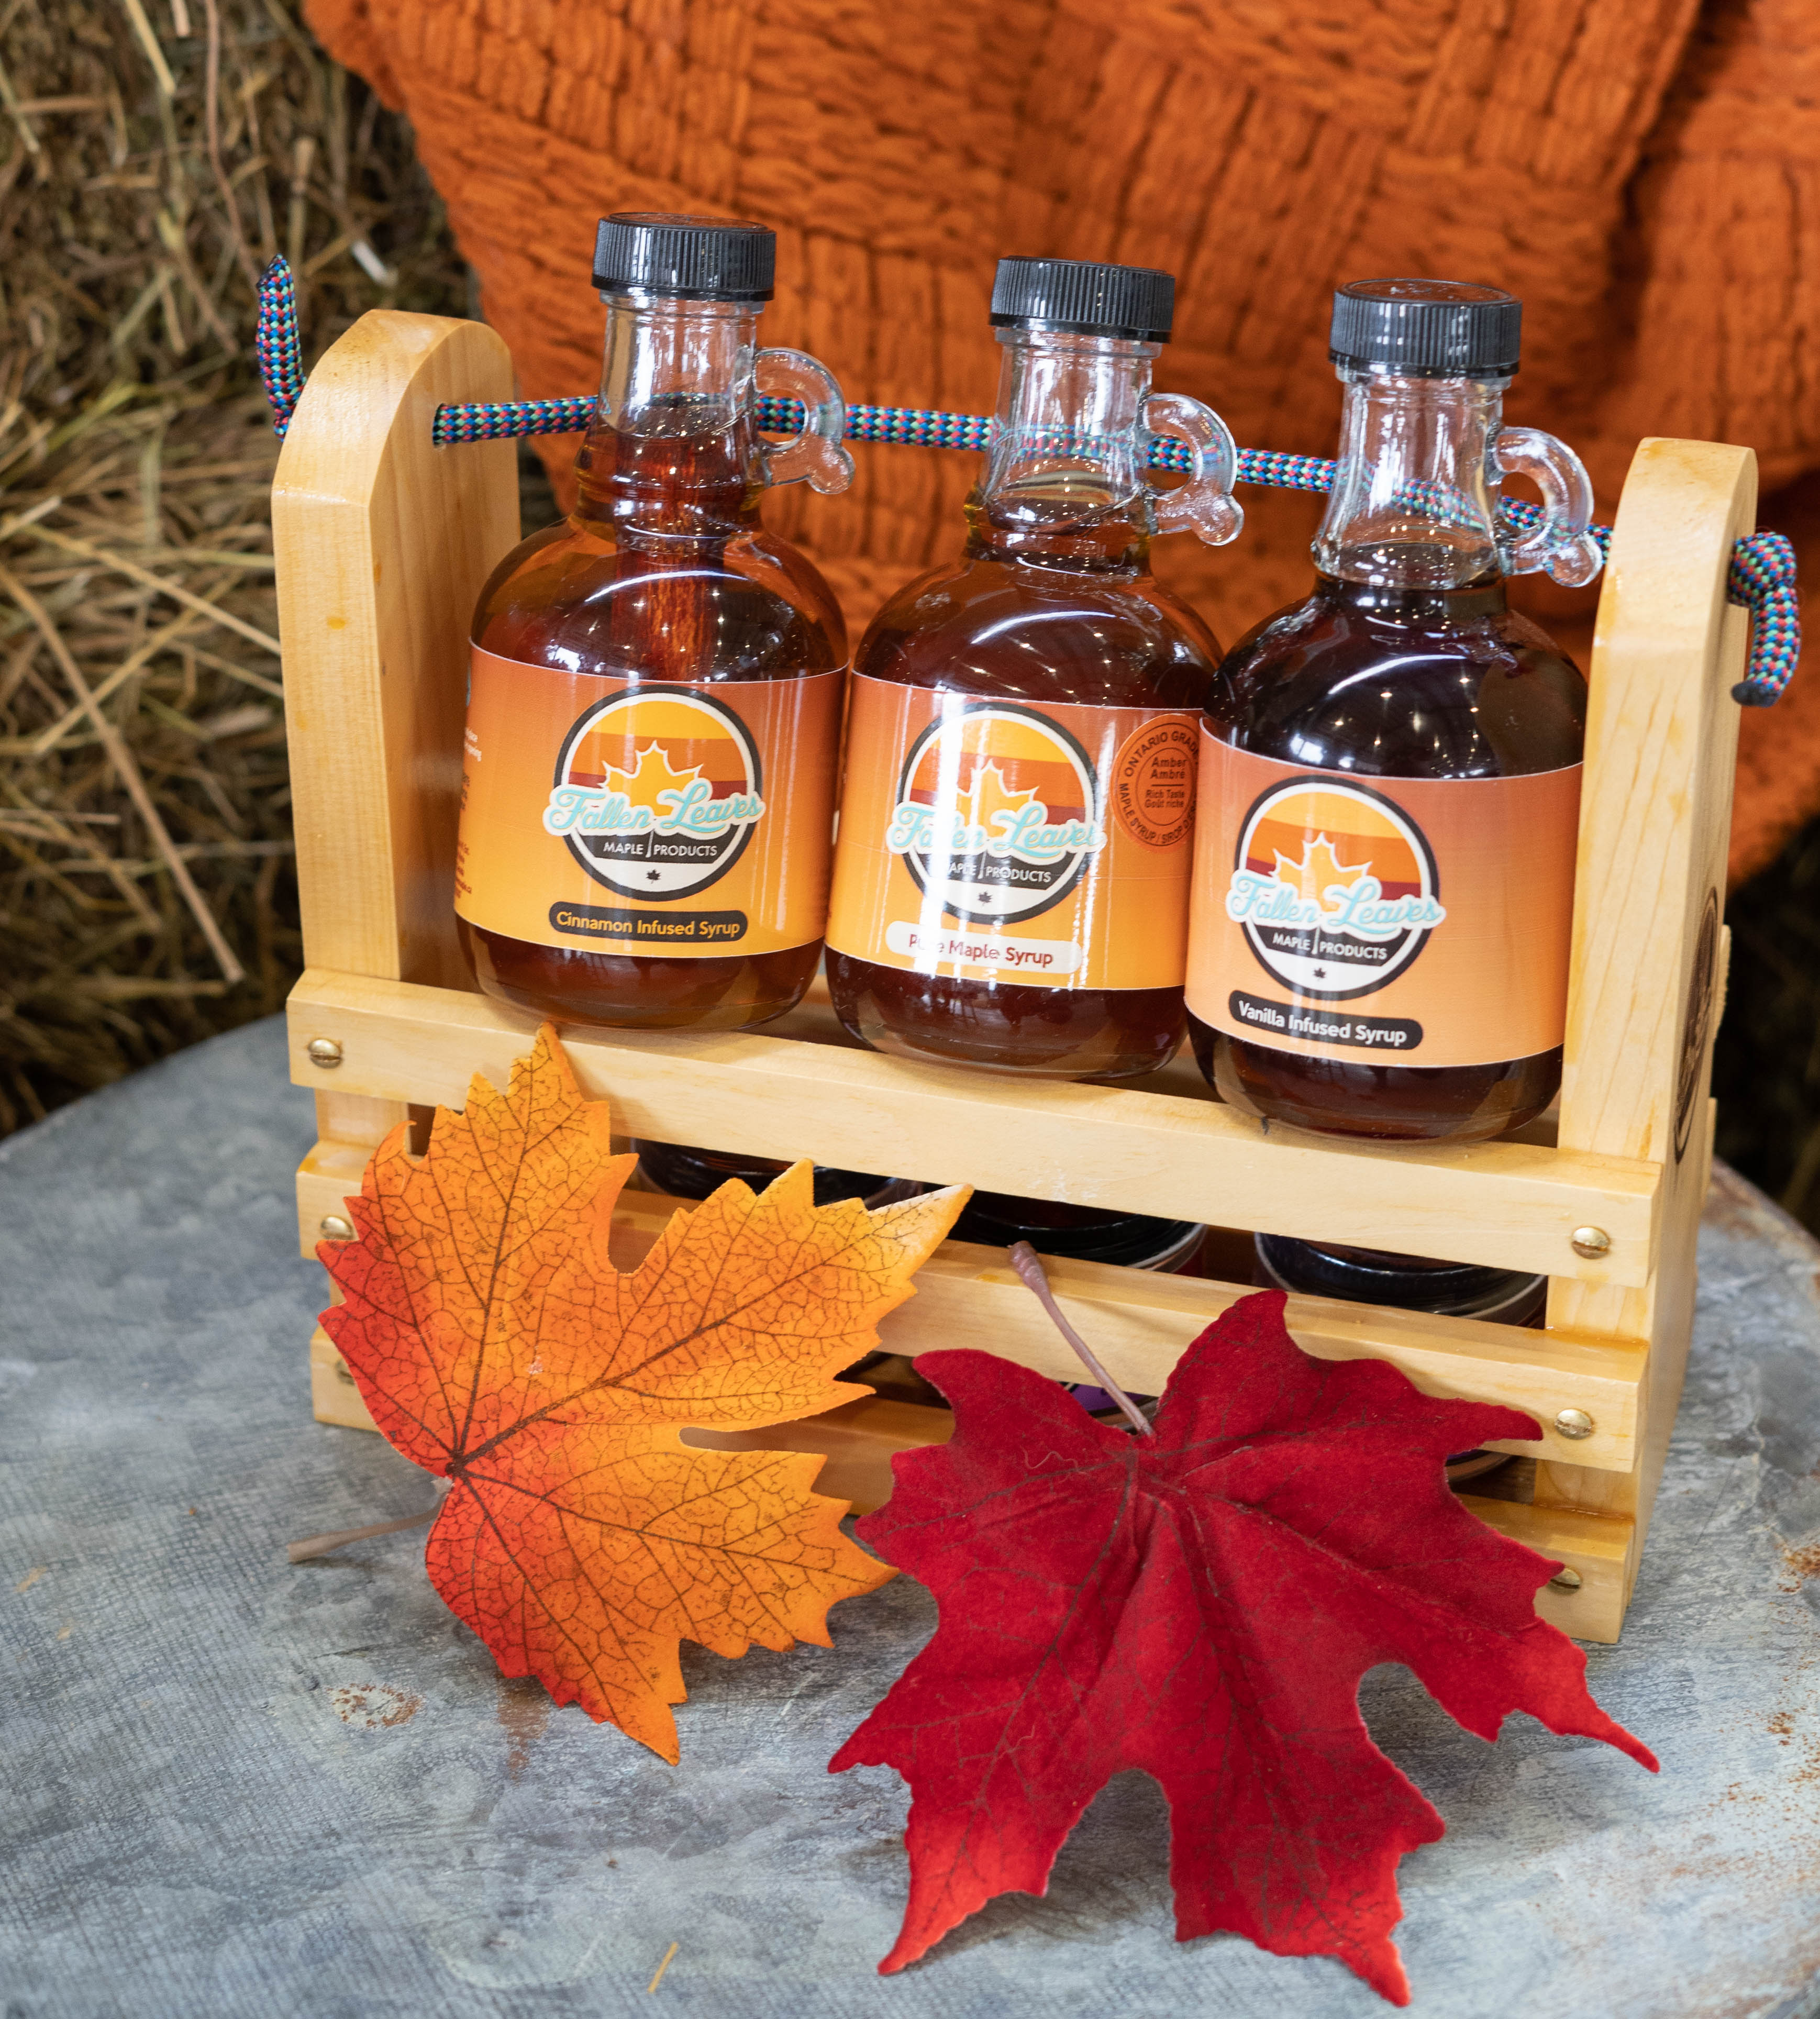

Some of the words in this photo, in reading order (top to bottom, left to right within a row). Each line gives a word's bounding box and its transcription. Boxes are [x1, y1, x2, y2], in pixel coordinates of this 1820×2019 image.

[1124, 732, 1168, 777] ONTARIO
[1151, 757, 1187, 767] Amber
[549, 789, 651, 830] Fallen
[660, 782, 762, 833] Leaves
[1119, 783, 1135, 819] MAPLE
[1130, 817, 1157, 840] SYRUP
[603, 841, 643, 856] MAPLE
[653, 846, 718, 856] PRODUCTS
[940, 860, 977, 877] APLE
[985, 866, 1051, 883] PRODUCTS
[1230, 876, 1317, 922] Fallen
[1327, 882, 1442, 934] Leaves
[556, 911, 632, 934] Cinnamon
[637, 920, 695, 936] Infused
[698, 921, 740, 939] Syrup
[949, 940, 1001, 961] Maple
[1005, 947, 1053, 968] Syrup
[1272, 933, 1311, 951] MAPLE
[1319, 941, 1388, 960] PRODUCTS
[1238, 1000, 1285, 1027] Vanilla
[1289, 1014, 1351, 1039] Infused
[1355, 1025, 1407, 1047] Syrup
